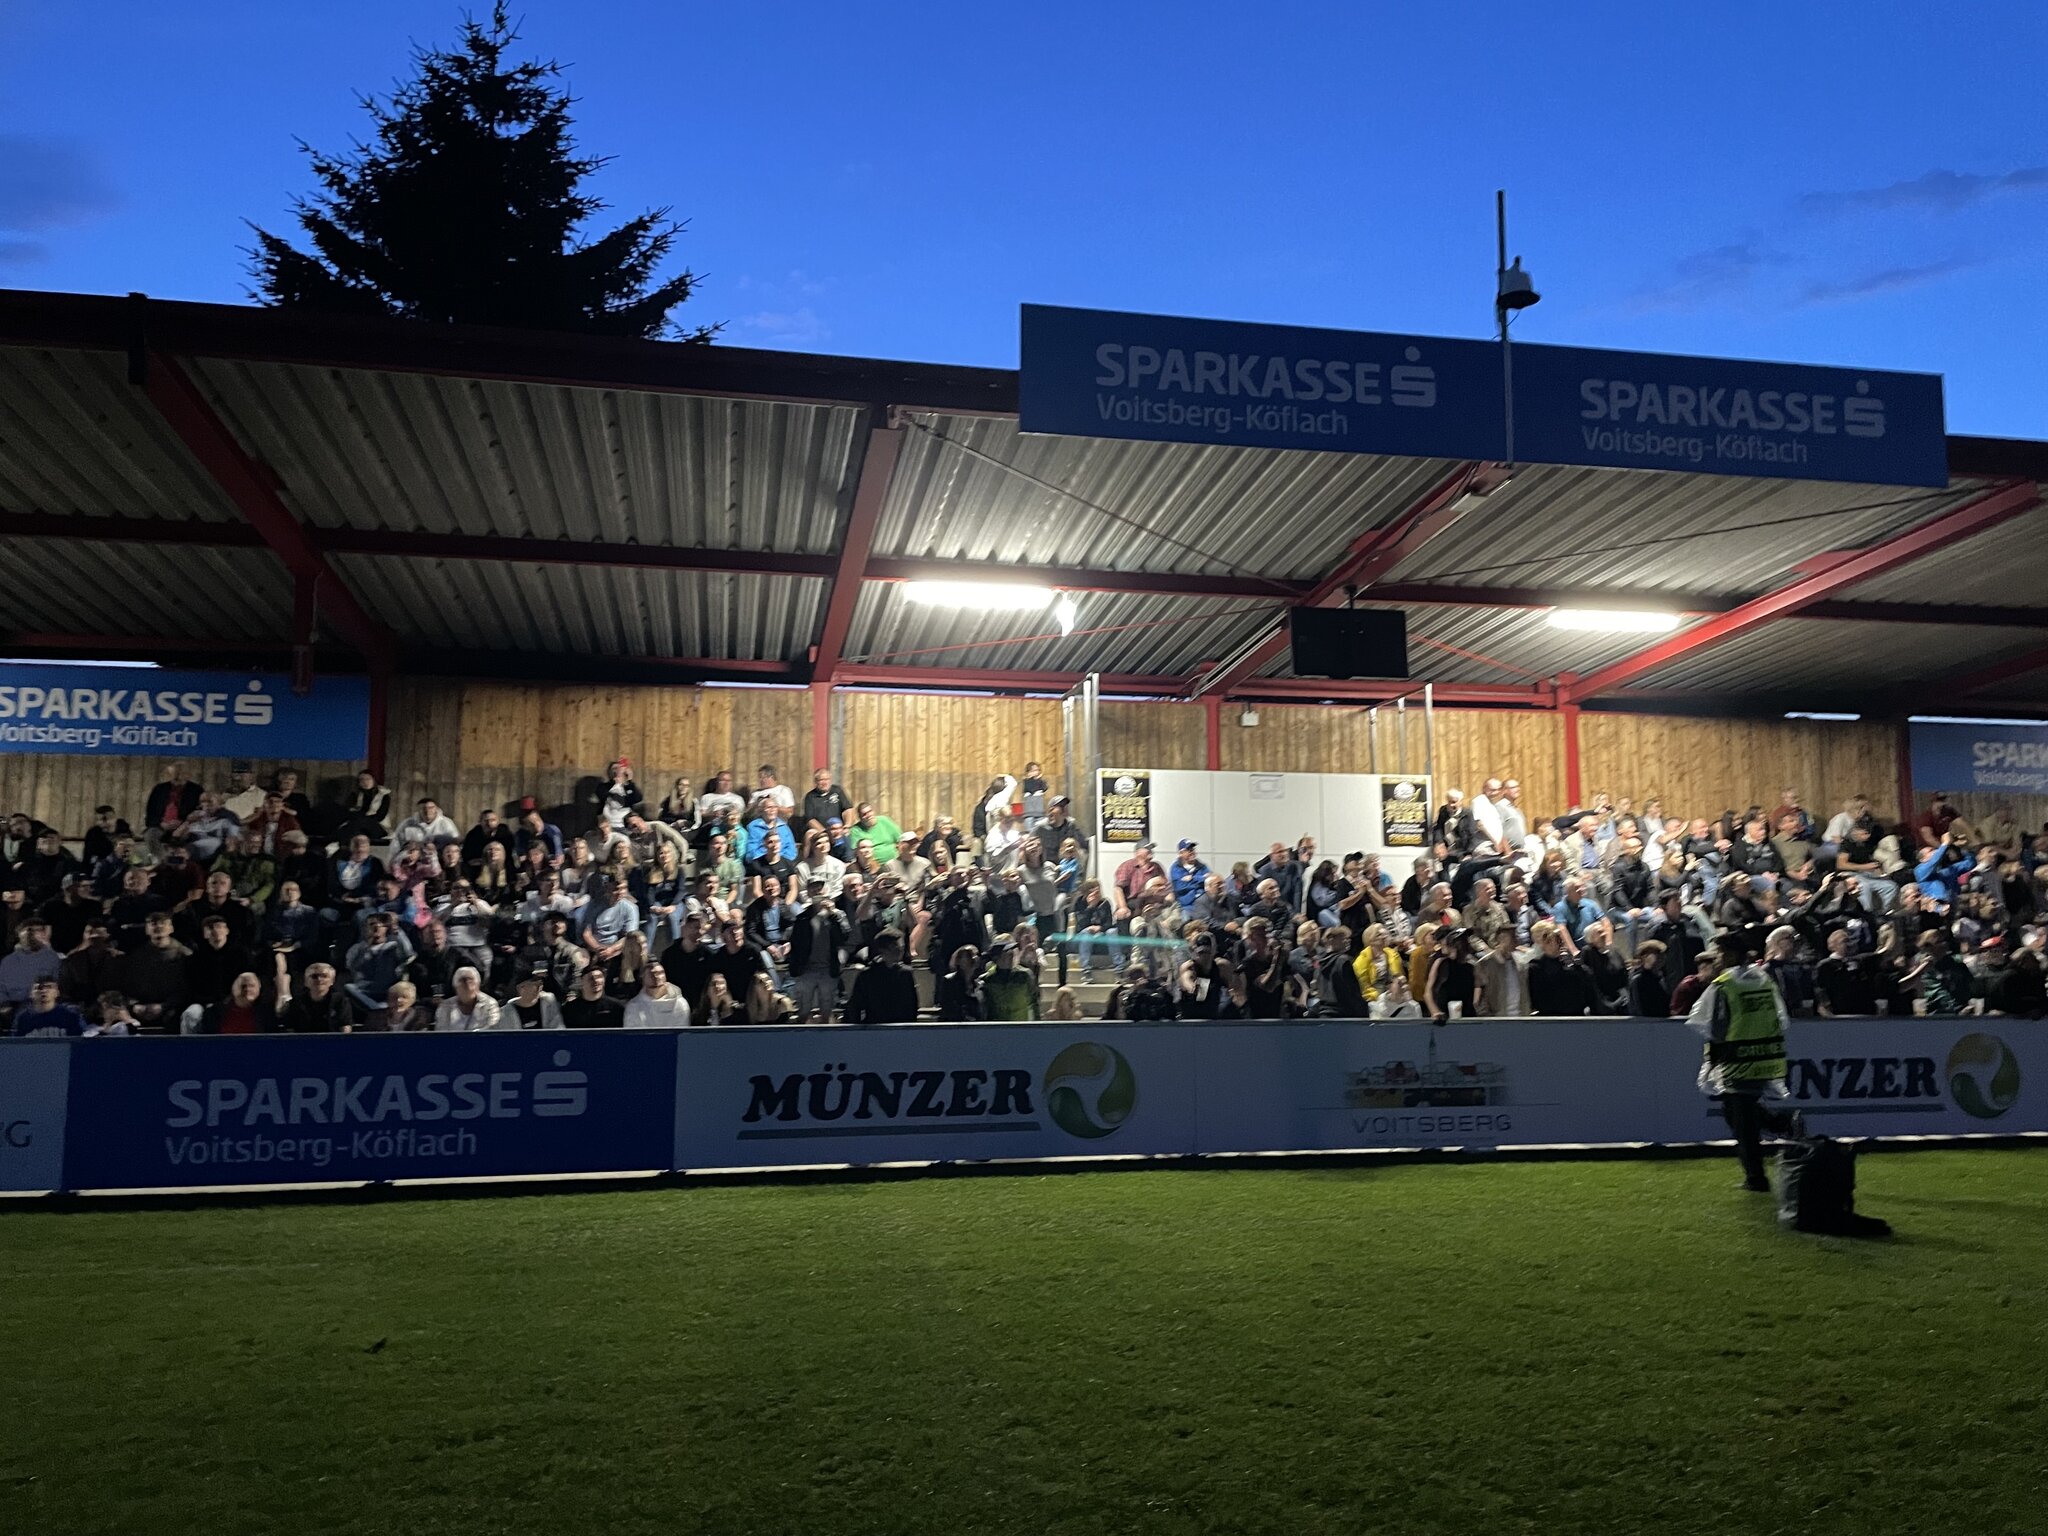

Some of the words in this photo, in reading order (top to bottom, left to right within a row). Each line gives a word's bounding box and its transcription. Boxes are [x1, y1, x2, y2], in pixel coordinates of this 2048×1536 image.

[1096, 344, 1381, 404] SPARKASSE
[1097, 394, 1349, 436] Voitsberg-Köflach
[1579, 378, 1837, 435] SPARKASSE
[1581, 425, 1808, 464] Voitsberg-Köflach
[0, 686, 228, 724] SPARKASSE
[743, 1063, 1034, 1122] MÜNZER
[1785, 1057, 1939, 1099] NZER
[165, 1072, 523, 1128] SPARKASSE
[1354, 1114, 1511, 1133] VOITSBERG
[164, 1127, 478, 1168] Voitsberg-Köflach
